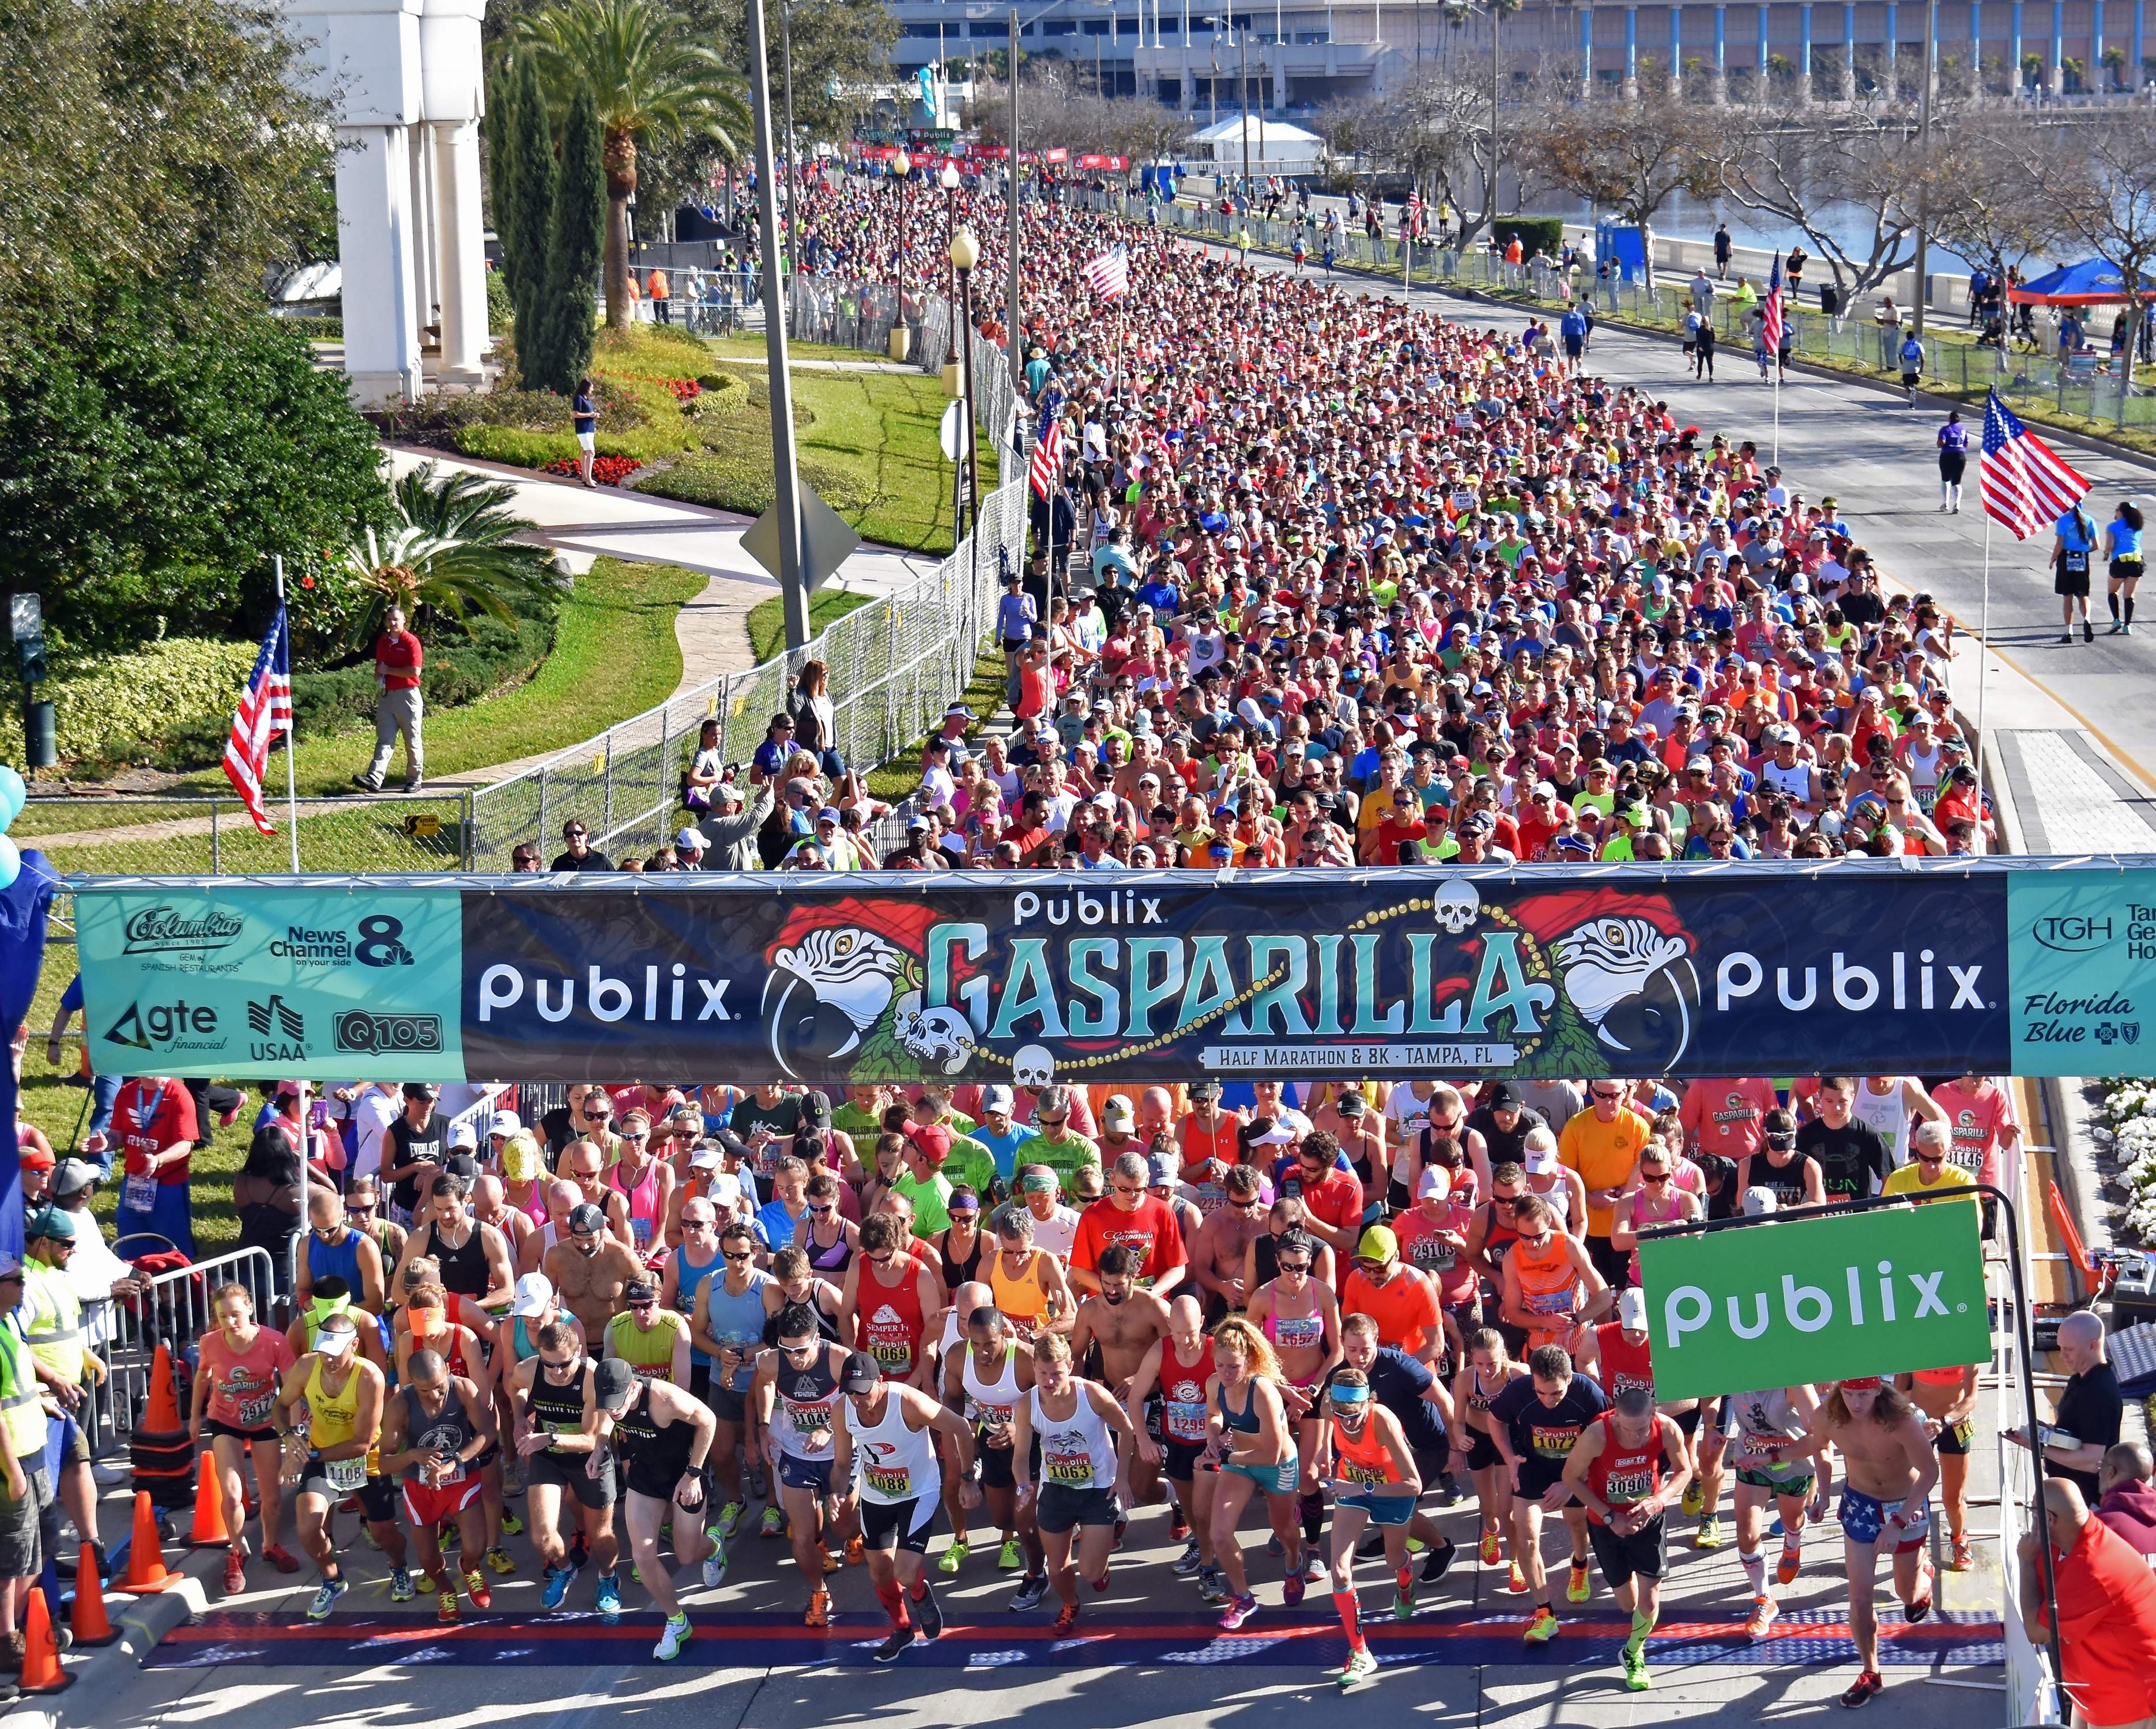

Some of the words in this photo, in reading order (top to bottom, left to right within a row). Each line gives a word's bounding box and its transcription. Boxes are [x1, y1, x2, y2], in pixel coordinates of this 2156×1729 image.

[1014, 890, 1162, 925] Publix
[125, 906, 243, 941] Columbia
[2043, 917, 2112, 941] TGH
[288, 926, 346, 943] News
[355, 915, 403, 967] 8
[179, 953, 195, 961] GEM
[197, 954, 205, 963] of
[270, 941, 352, 958] Channel
[141, 964, 176, 972] SPANISH
[179, 963, 239, 973] RESTAURANTS
[308, 960, 330, 968] your
[928, 923, 1555, 1038] GASPARILLA
[1717, 949, 1986, 1011] Publix
[479, 963, 731, 1022] Publix
[2023, 991, 2135, 1015] Florida
[148, 999, 218, 1038] gte
[339, 1009, 440, 1057] Q105
[2023, 1018, 2086, 1043] Blue
[164, 1036, 227, 1054] financial
[251, 1043, 307, 1062] USAA
[1219, 1048, 1258, 1066] HALF
[1264, 1048, 1347, 1066] MARATHON
[1352, 1048, 1362, 1065] &
[1369, 1047, 1389, 1065] 8K
[1405, 1047, 1468, 1066] TAMPA,
[1474, 1047, 1493, 1063] FL
[409, 1139, 440, 1158] EVERLAST
[1955, 1145, 1982, 1153] Publix
[1664, 1260, 1951, 1348] Publix
[866, 1323, 897, 1332] SEMPER
[879, 1339, 909, 1347] Publix
[1281, 1332, 1316, 1346] 1657
[871, 1346, 907, 1360] 1069
[640, 1367, 669, 1375] Publix
[1626, 1378, 1652, 1388] Publi
[798, 1405, 830, 1414] Publix
[1173, 1418, 1206, 1431] 1299
[1538, 1436, 1577, 1448] 1072
[1056, 1456, 1089, 1466] Publix
[330, 1467, 361, 1481] 1108
[875, 1471, 906, 1479] Publix
[1051, 1465, 1089, 1478] 1063
[1277, 1466, 1295, 1491] NIKE
[1620, 1470, 1651, 1480] Publix
[868, 1475, 906, 1491] 1088
[1608, 1474, 1653, 1493] 30908
